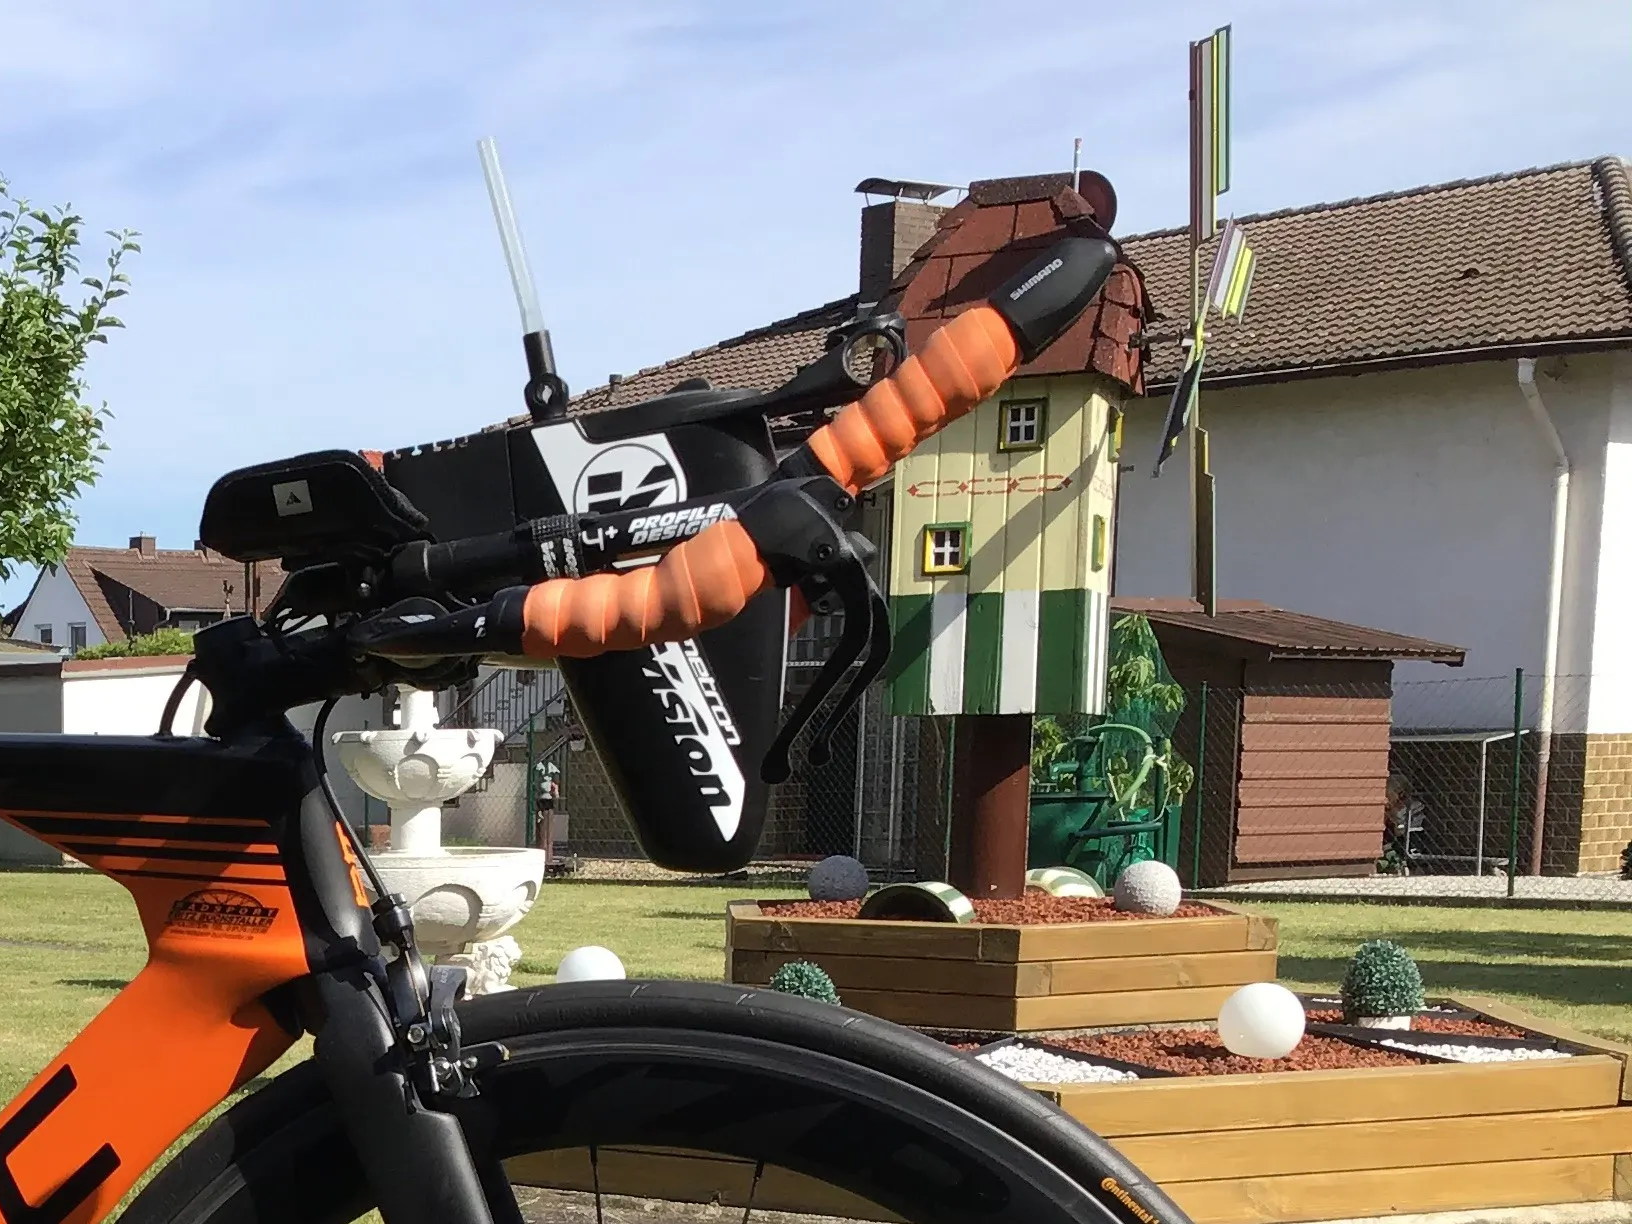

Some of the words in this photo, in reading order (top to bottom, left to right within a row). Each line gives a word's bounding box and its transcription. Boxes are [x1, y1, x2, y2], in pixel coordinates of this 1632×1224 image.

[1009, 258, 1064, 301] SHIMANO
[627, 502, 725, 534] PROFILE
[630, 518, 719, 546] DESIGN
